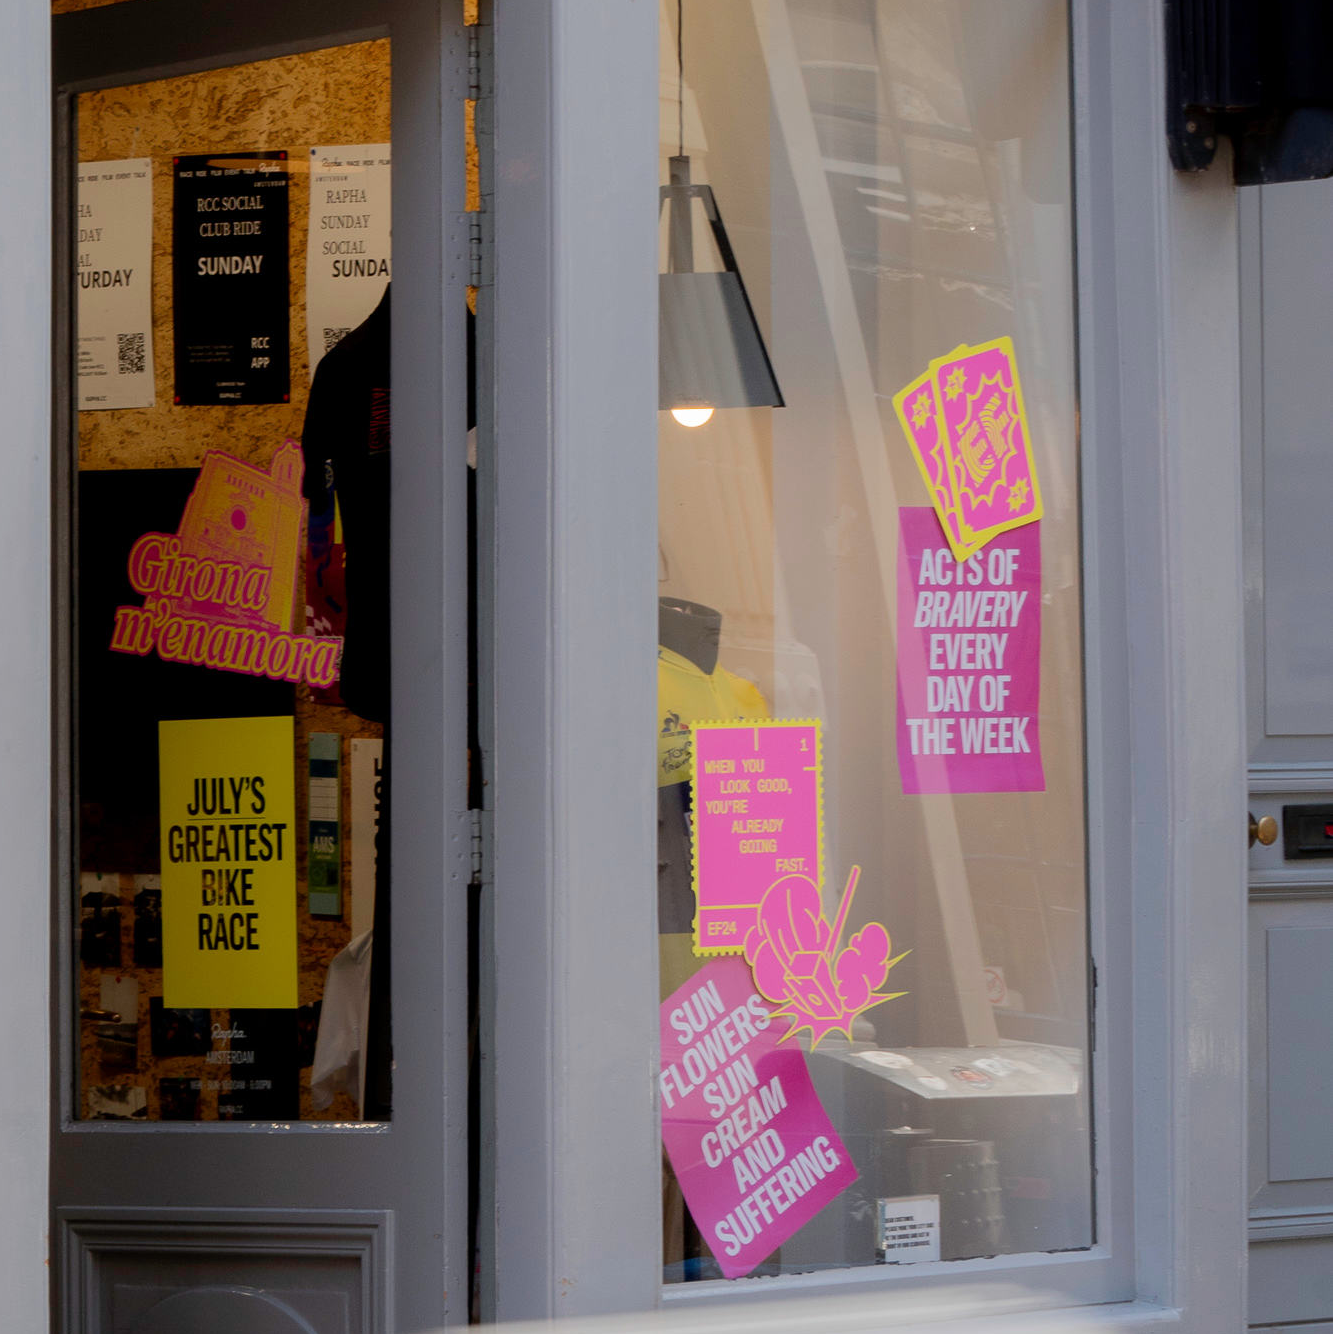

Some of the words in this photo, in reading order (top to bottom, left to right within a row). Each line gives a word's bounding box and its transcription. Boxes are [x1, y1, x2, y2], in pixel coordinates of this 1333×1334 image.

[197, 197, 220, 213] RCC
[221, 195, 265, 211] SOCIAL
[325, 189, 367, 204] RAPHA
[199, 221, 231, 238] CLUB
[233, 220, 262, 236] RIDE
[320, 214, 370, 230] SUNDAY
[322, 240, 366, 256] SOCIAL
[197, 254, 264, 276] SUNDAY
[332, 258, 391, 278] SUNDA
[78, 269, 133, 289] URDAY
[250, 336, 270, 350] RCC
[250, 356, 271, 370] APP
[128, 533, 271, 612] Girona
[988, 548, 1021, 586] OF
[914, 591, 1028, 628] BRAVERY
[929, 633, 1009, 670] EVERY
[927, 675, 975, 713] DAY
[979, 674, 1012, 712] OF
[906, 718, 957, 755] THE
[960, 717, 1031, 755] WEEK
[704, 760, 736, 774] WHEN
[741, 758, 765, 773] YOU
[187, 776, 266, 816] JULY'S
[720, 779, 751, 794] LOOK
[705, 799, 749, 815] YOU'RE
[731, 818, 784, 834] ALREADY
[168, 823, 287, 863] GREATEST
[739, 838, 778, 854] GOING
[202, 867, 254, 907] BIKE
[198, 912, 260, 952] RACE
[707, 921, 738, 936] EF24
[669, 979, 726, 1046] SUN
[210, 1021, 248, 1047] Rapha
[658, 994, 772, 1110] FLOWERS
[703, 1053, 761, 1119] SUN
[700, 1075, 788, 1169] CREAM
[731, 1128, 787, 1195] AND
[714, 1136, 842, 1258] SUFFERING
